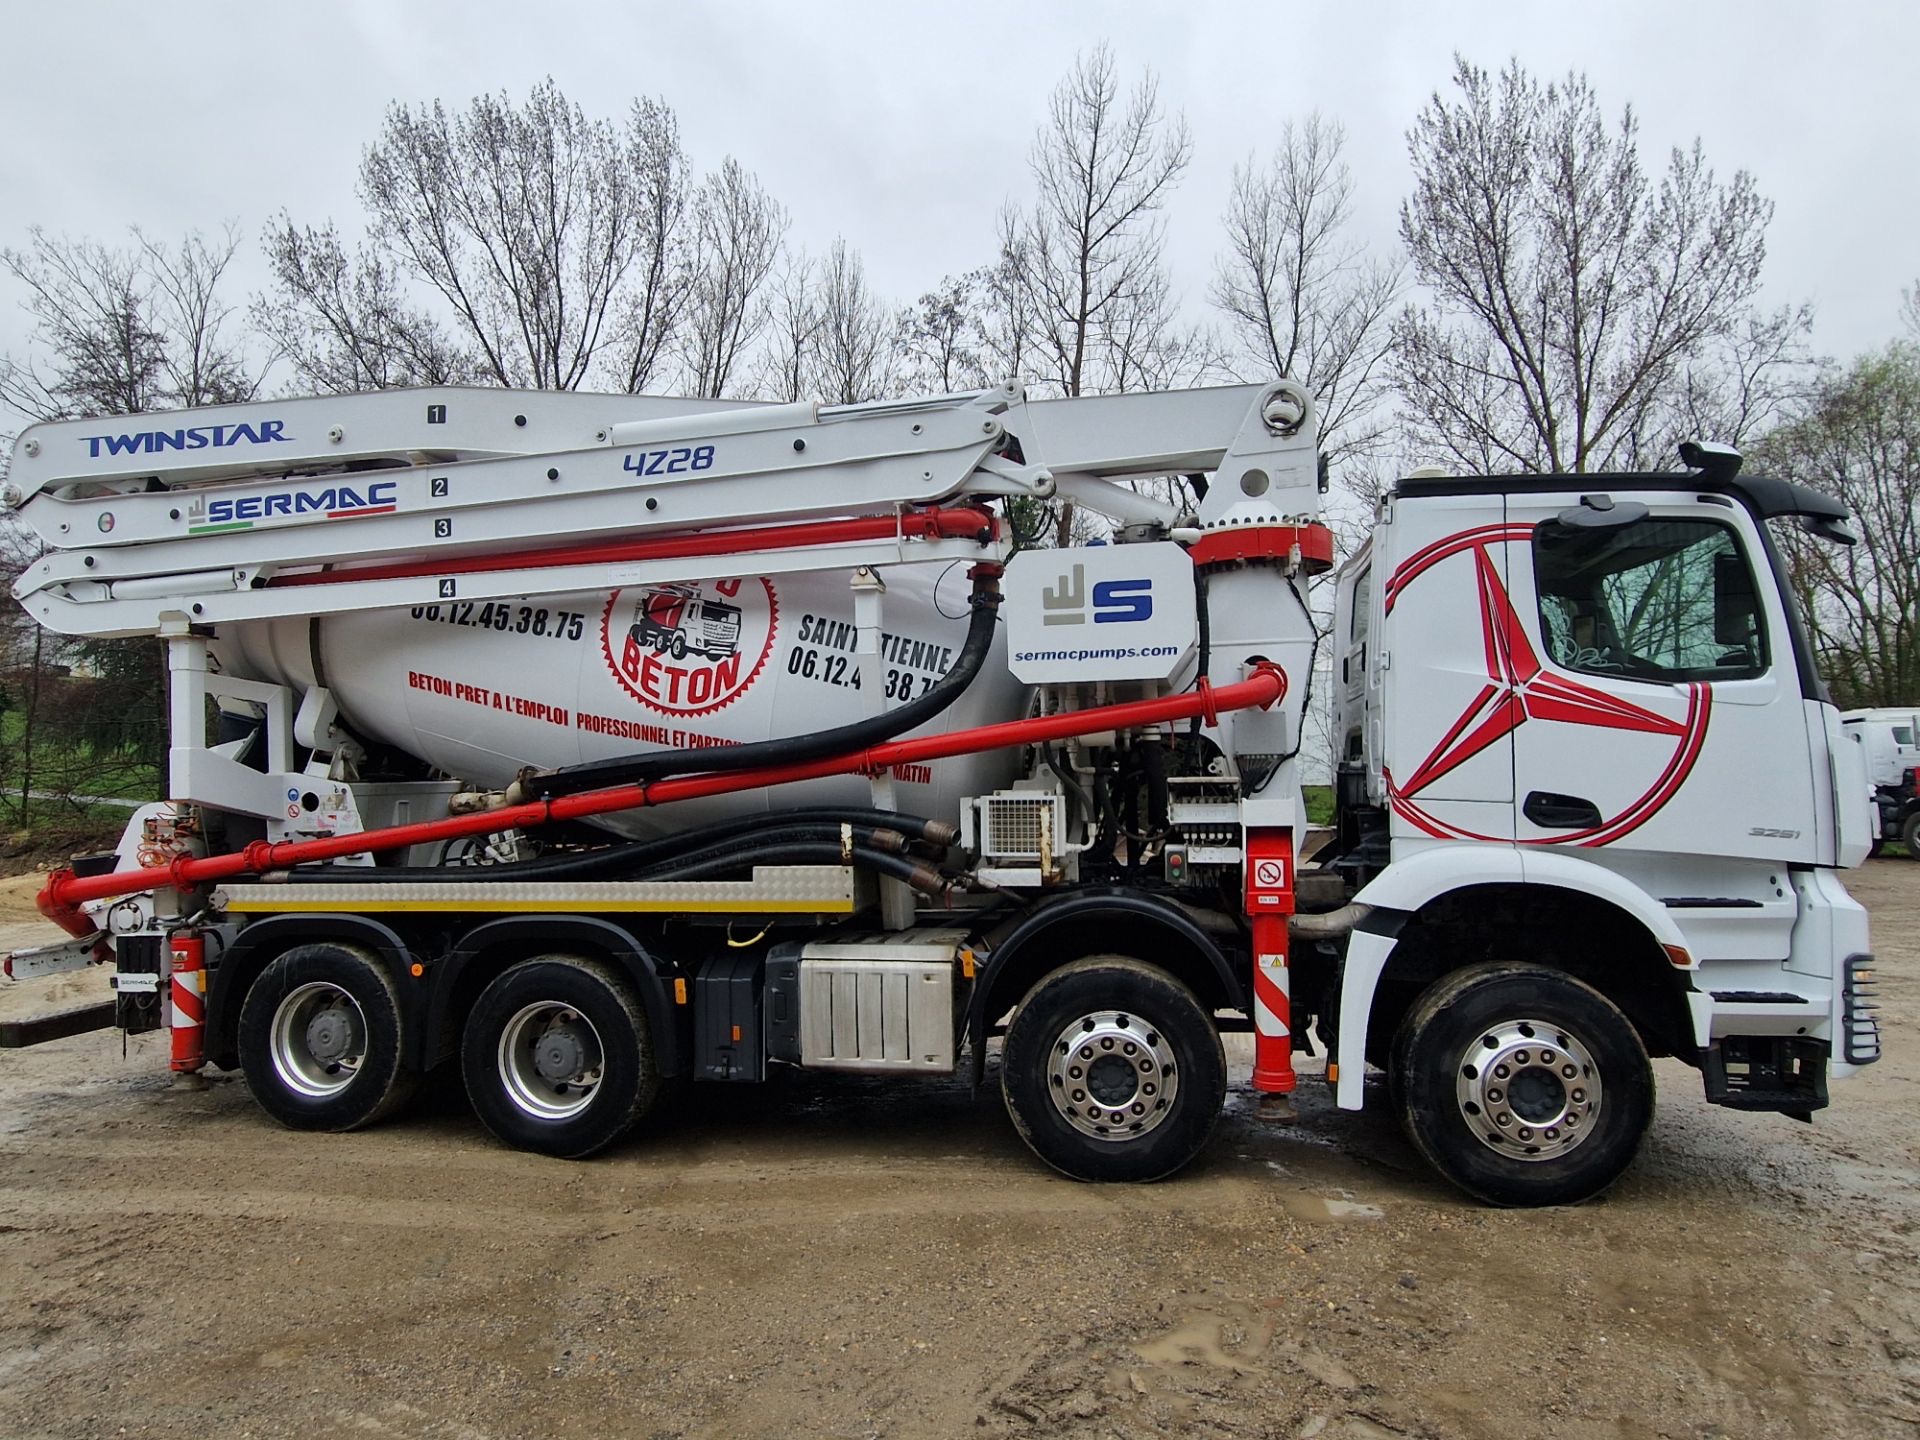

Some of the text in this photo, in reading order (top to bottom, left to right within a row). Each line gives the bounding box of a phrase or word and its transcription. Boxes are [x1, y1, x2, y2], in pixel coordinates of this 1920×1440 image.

[78, 420, 296, 457] TWINSTAR
[623, 445, 715, 477] 4Z28
[208, 482, 397, 522] SERMAC
[881, 632, 952, 675] TIENNE
[1015, 646, 1178, 662] sermacpumps.com
[409, 670, 452, 697] BETON
[455, 682, 490, 706] PRET
[493, 692, 502, 710] A
[505, 695, 569, 726] L'EMPLOI
[576, 712, 670, 746] PROFESSIONNEL
[673, 730, 686, 748] ET
